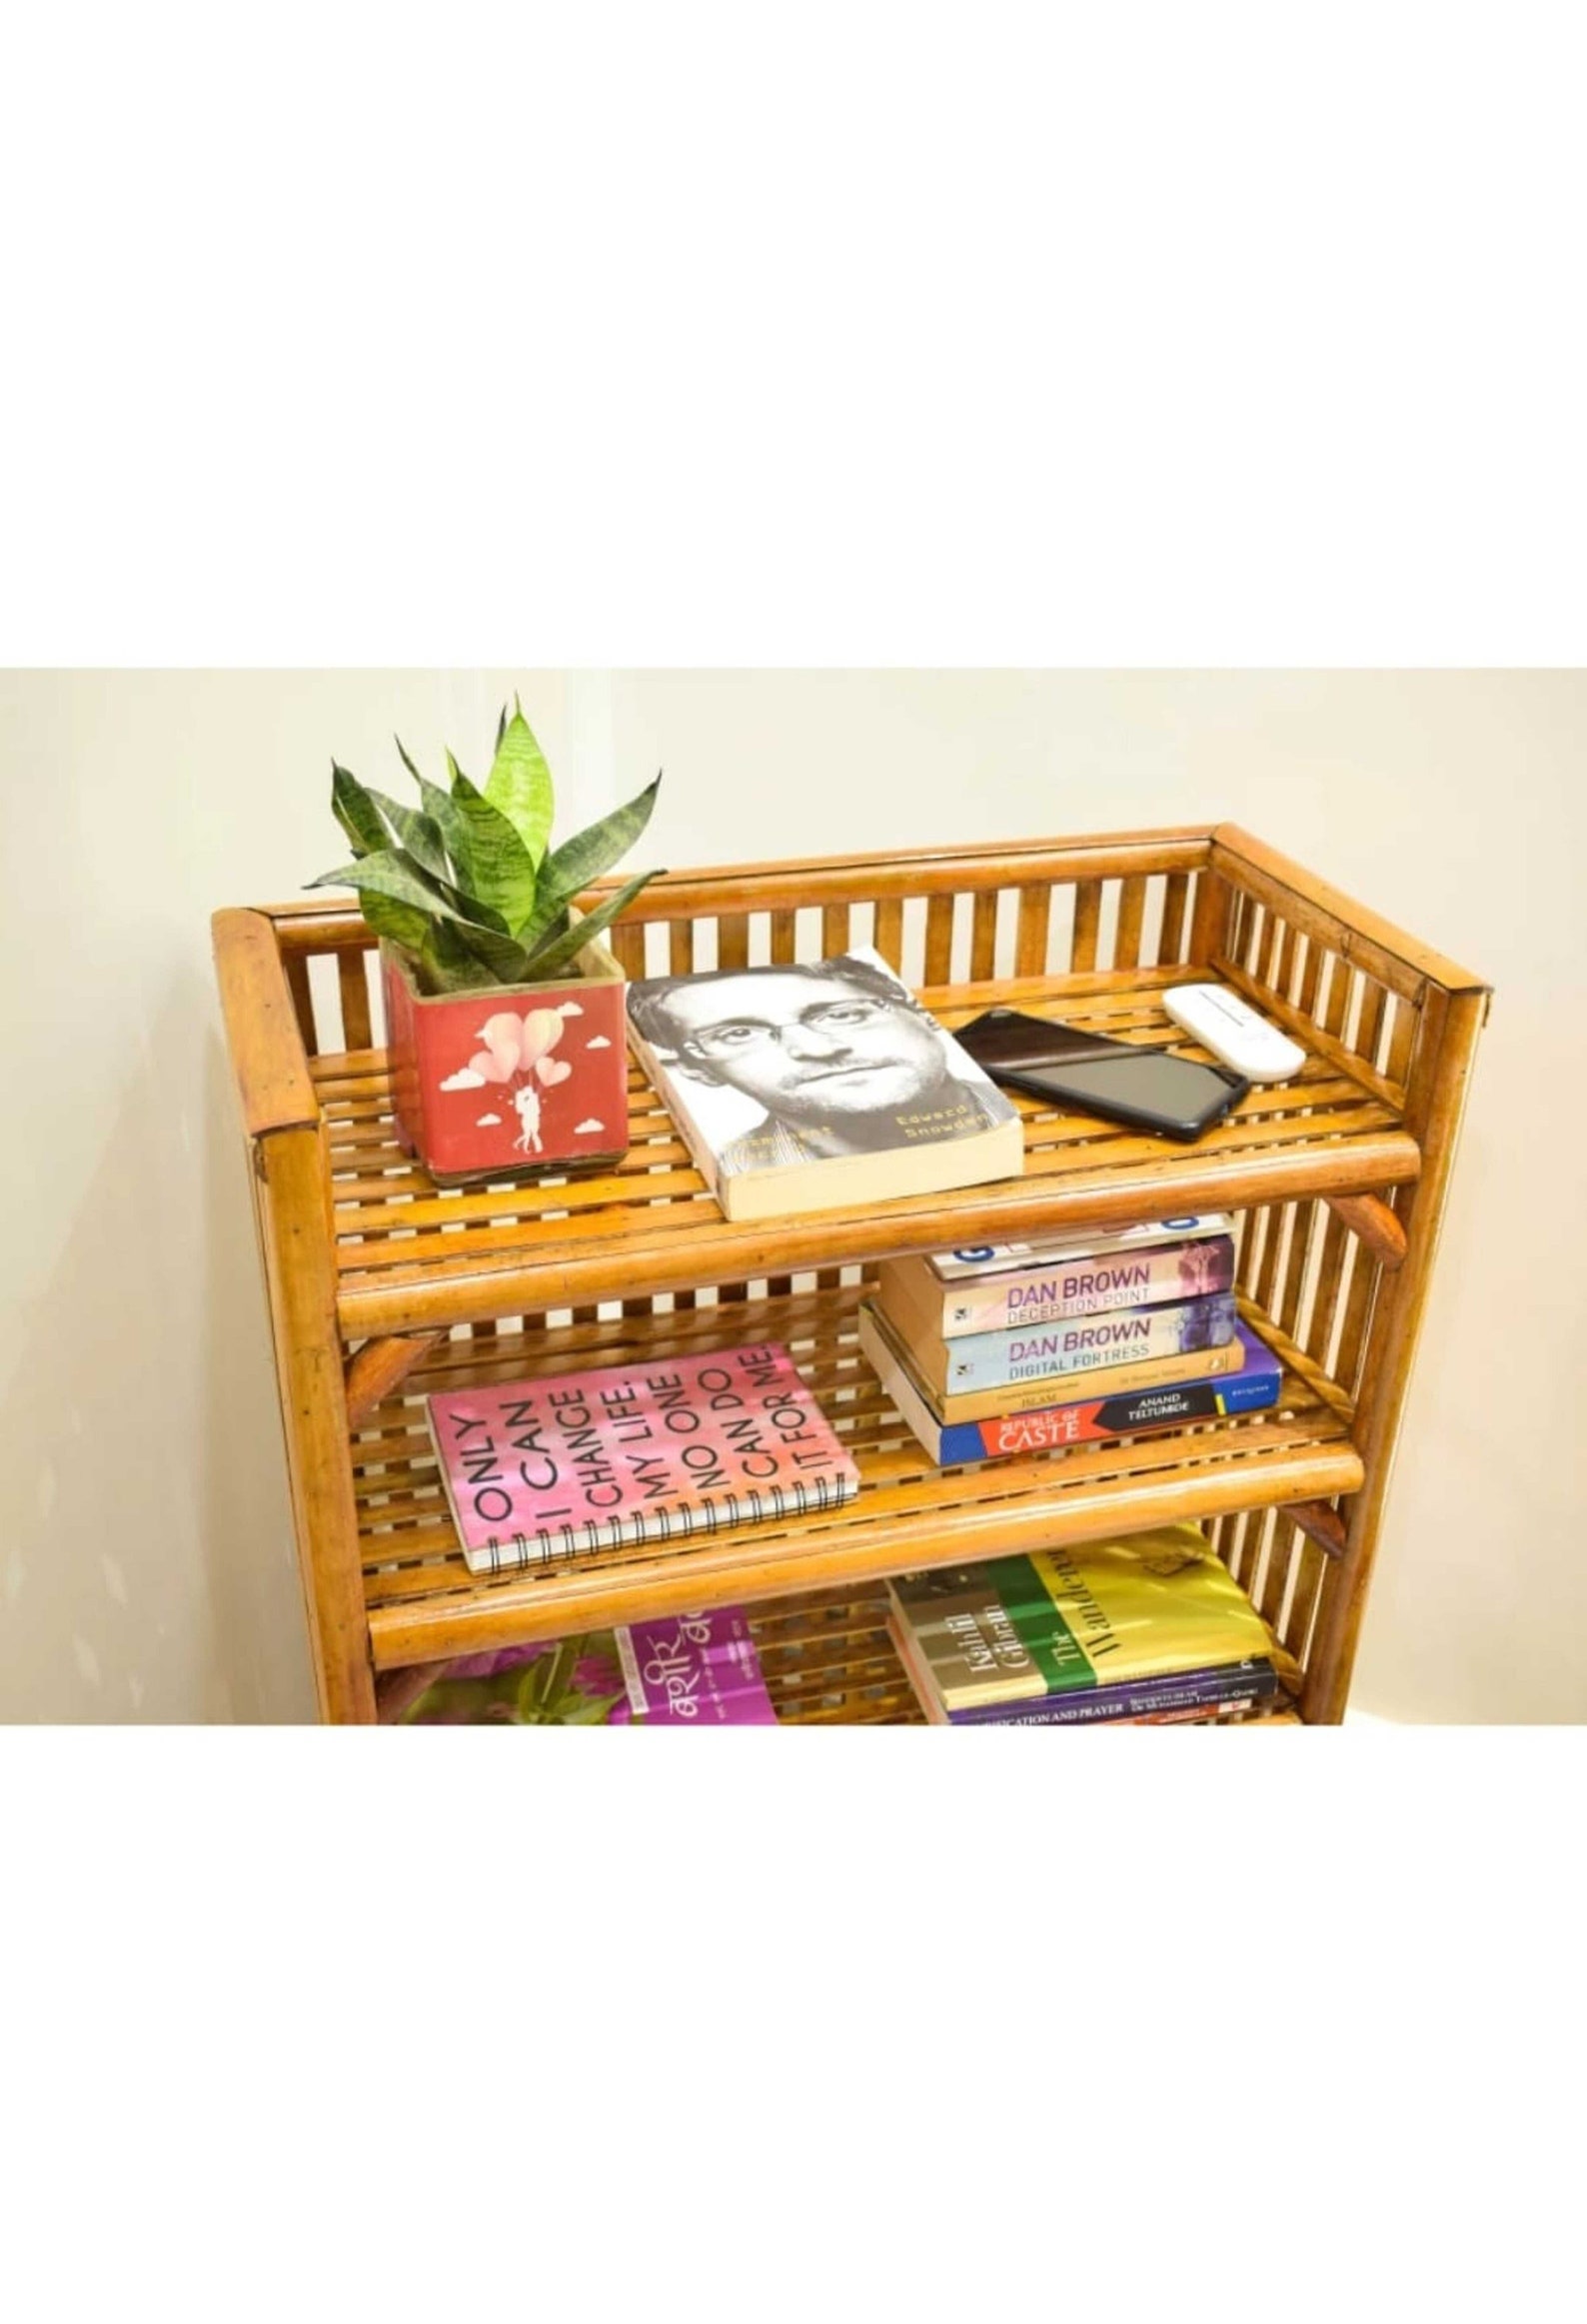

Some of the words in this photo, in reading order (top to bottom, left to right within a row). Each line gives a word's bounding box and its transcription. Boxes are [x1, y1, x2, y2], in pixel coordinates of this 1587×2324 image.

[1007, 1280, 1057, 1308] DAN
[1062, 1263, 1151, 1298] BROWN
[1007, 1299, 1098, 1324] DECEPTION
[1103, 1287, 1150, 1309] POINT
[1009, 1334, 1059, 1362] DAN
[1064, 1317, 1152, 1352] BROWN
[1009, 1359, 1067, 1380] DIGITAL
[1072, 1343, 1150, 1371] FORTRESS
[601, 1380, 653, 1442] LIFE.
[647, 1373, 701, 1433] ONE
[698, 1368, 745, 1410] DO
[1138, 1392, 1181, 1408] ANAND
[762, 1392, 816, 1443] FOR
[998, 1421, 1081, 1451] CASTE
[1000, 1411, 1059, 1433] REPUBLIC
[1062, 1408, 1082, 1424] OF
[449, 1412, 513, 1522] ONLY
[499, 1400, 558, 1490] CAN
[548, 1388, 623, 1507] CHANGE
[682, 1445, 731, 1489] NO
[721, 1418, 779, 1477] CAN
[792, 1450, 833, 1470] IT
[626, 1455, 679, 1499] MY
[536, 1507, 572, 1518] I
[945, 1613, 998, 1673] Kahlil
[984, 1604, 1030, 1669] Gibran
[1051, 1631, 1081, 1666] The
[643, 1633, 701, 1717] बशीर
[1052, 1709, 1077, 1722] AND
[1079, 1703, 1123, 1717] PRAYER
